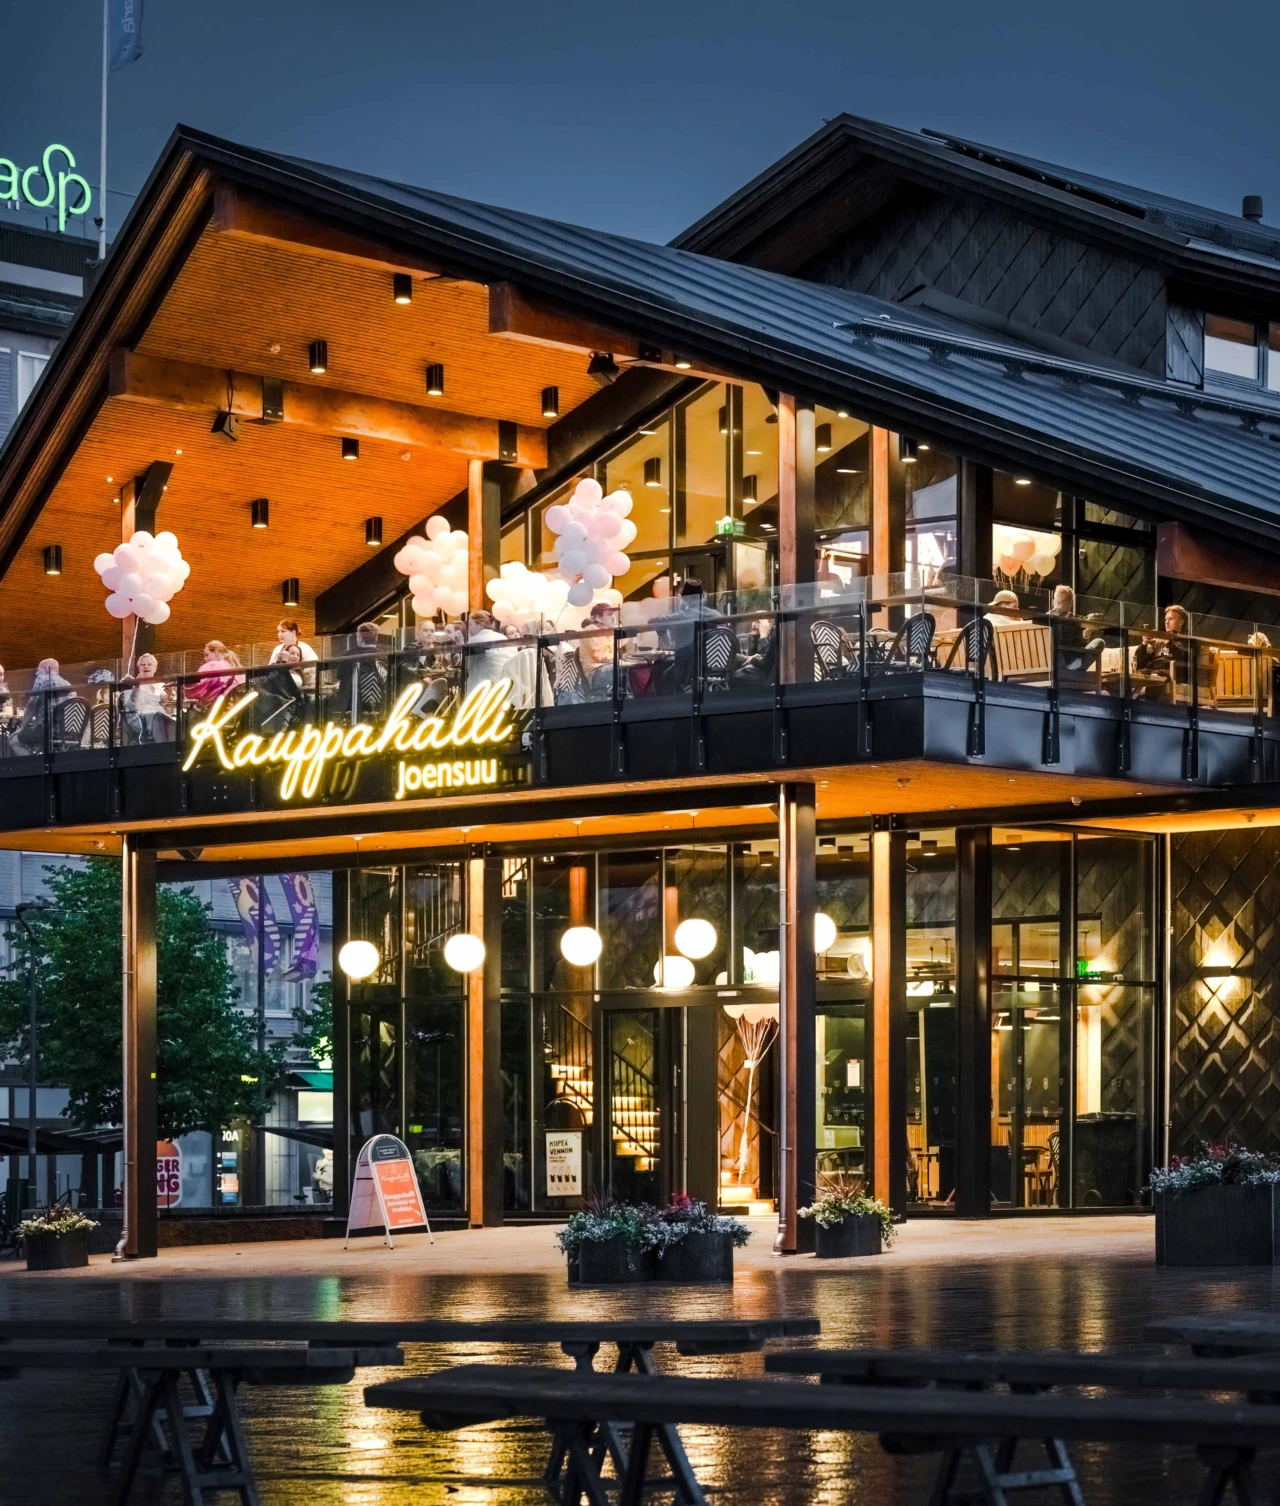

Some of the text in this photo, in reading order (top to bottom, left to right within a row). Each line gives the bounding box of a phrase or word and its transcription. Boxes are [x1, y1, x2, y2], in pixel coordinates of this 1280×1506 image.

[183, 678, 514, 799] Kauppahalli
[395, 758, 497, 799] Joensuu
[157, 1159, 179, 1173] GER
[157, 1174, 179, 1193] NG
